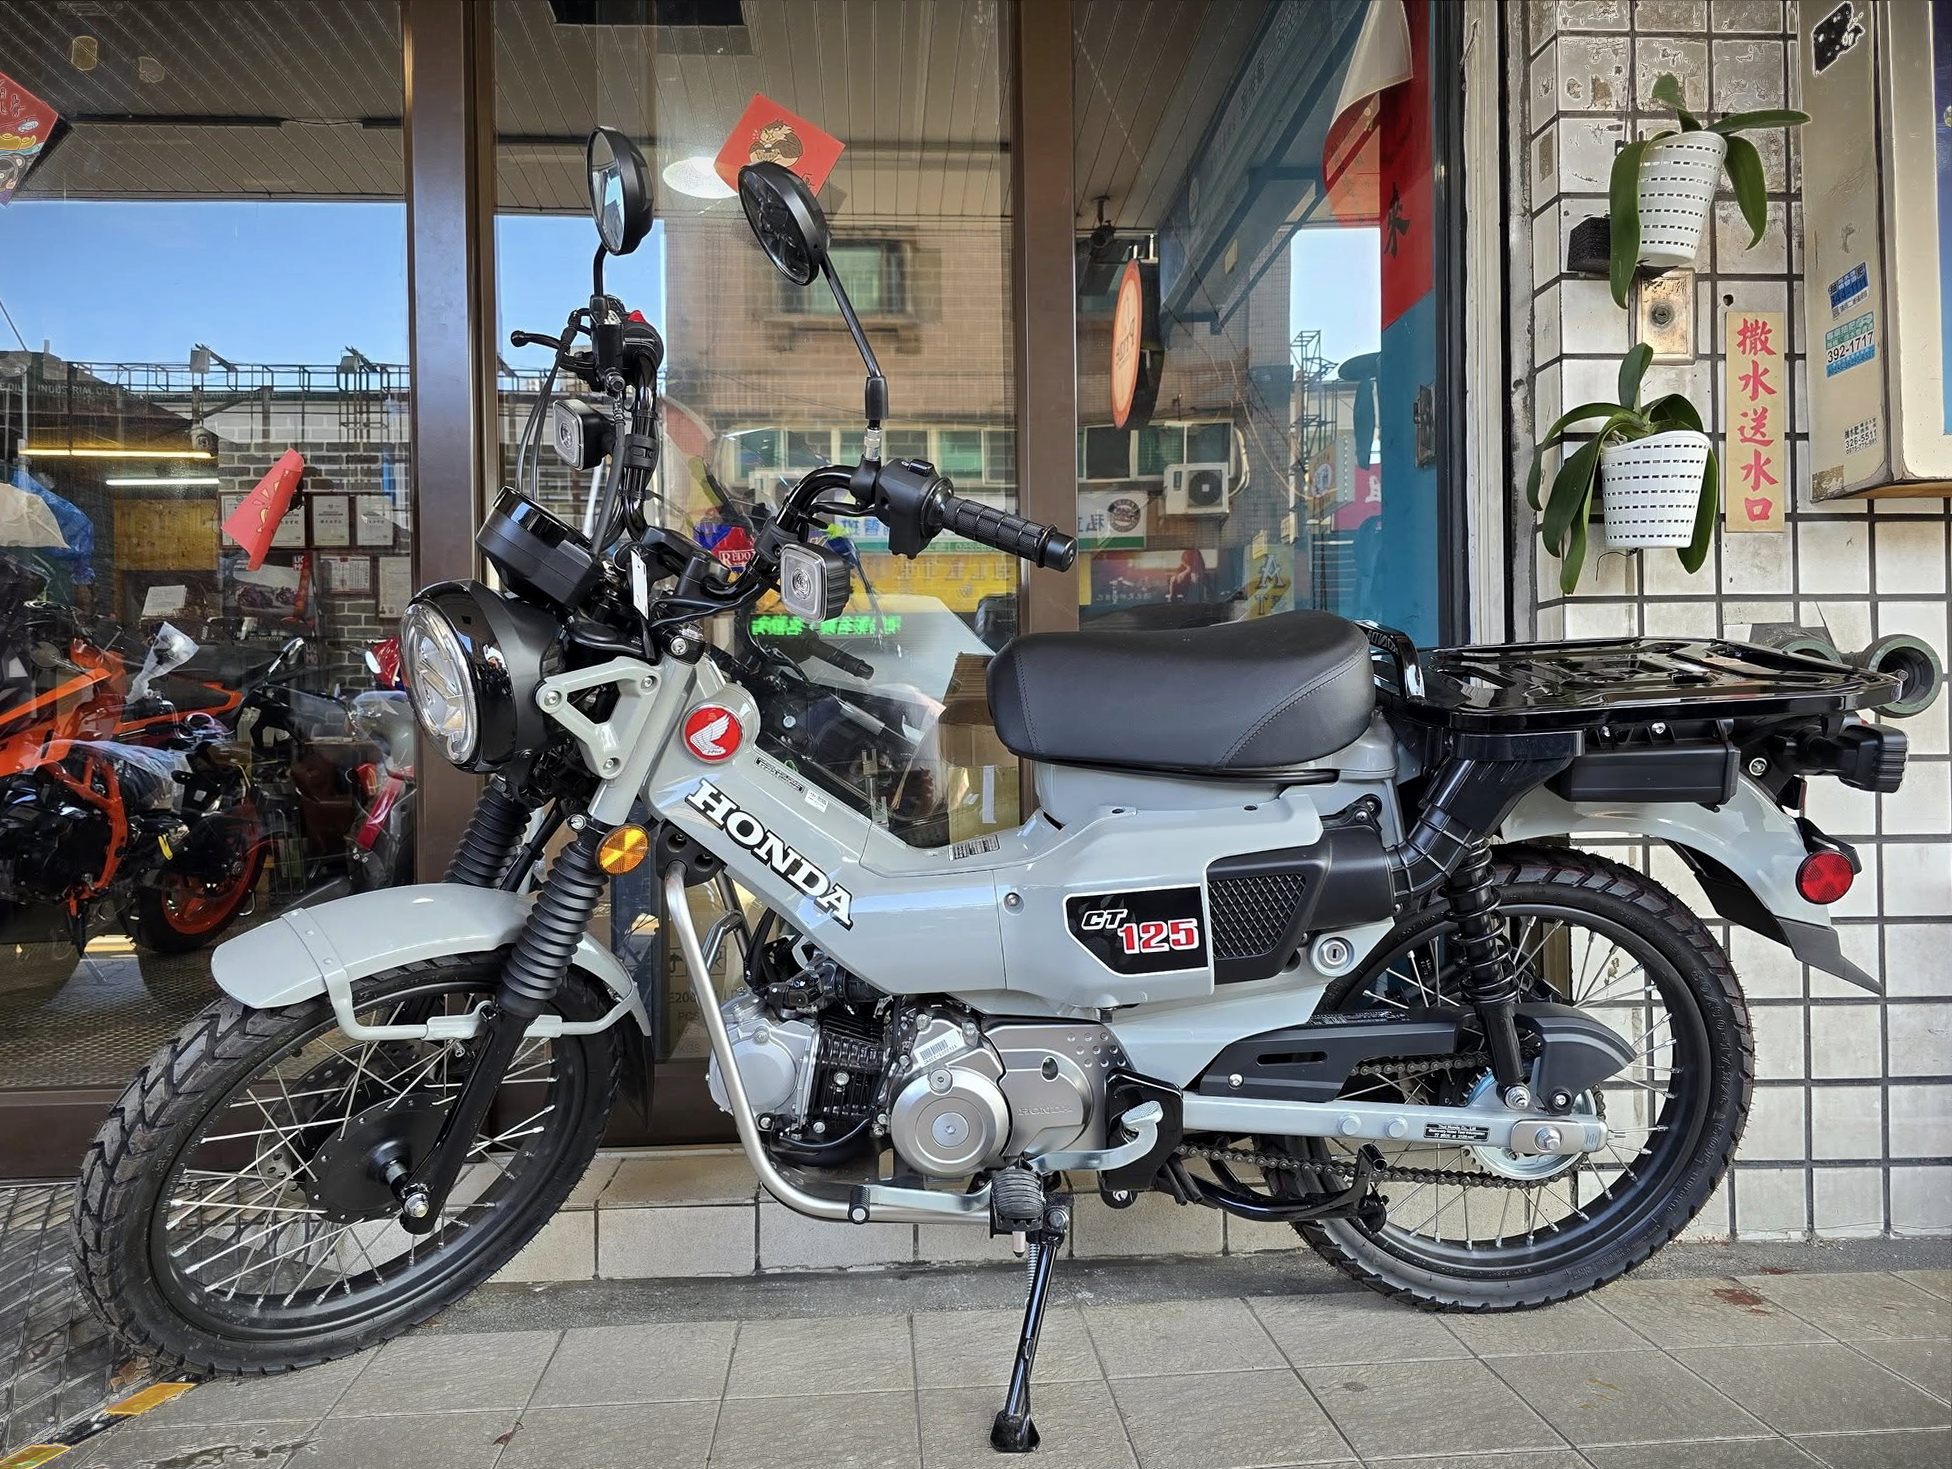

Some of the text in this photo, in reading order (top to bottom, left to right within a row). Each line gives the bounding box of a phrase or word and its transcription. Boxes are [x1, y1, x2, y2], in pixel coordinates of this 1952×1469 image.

[1827, 331, 1874, 363] 392-1717
[1736, 317, 1779, 522] 撒水送水口
[685, 777, 854, 931] HONDA
[1081, 908, 1128, 931] CT
[1117, 917, 1200, 955] 125
